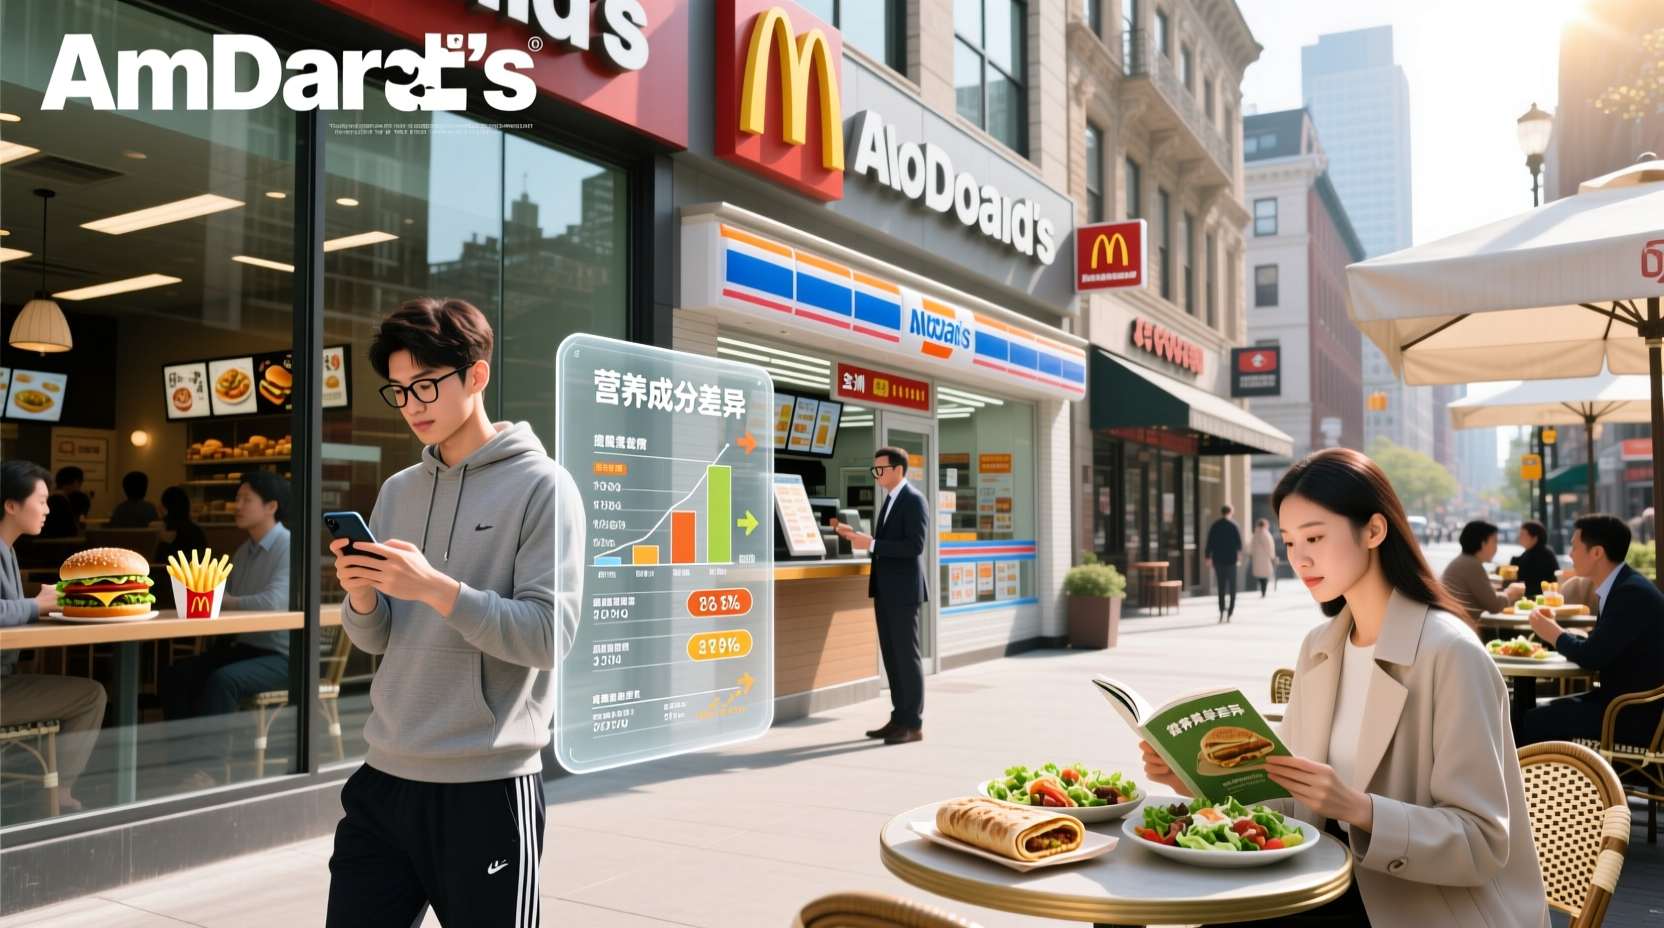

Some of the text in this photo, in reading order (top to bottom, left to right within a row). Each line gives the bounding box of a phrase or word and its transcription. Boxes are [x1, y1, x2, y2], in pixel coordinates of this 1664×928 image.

[593, 368, 746, 420] 营养成分差异
